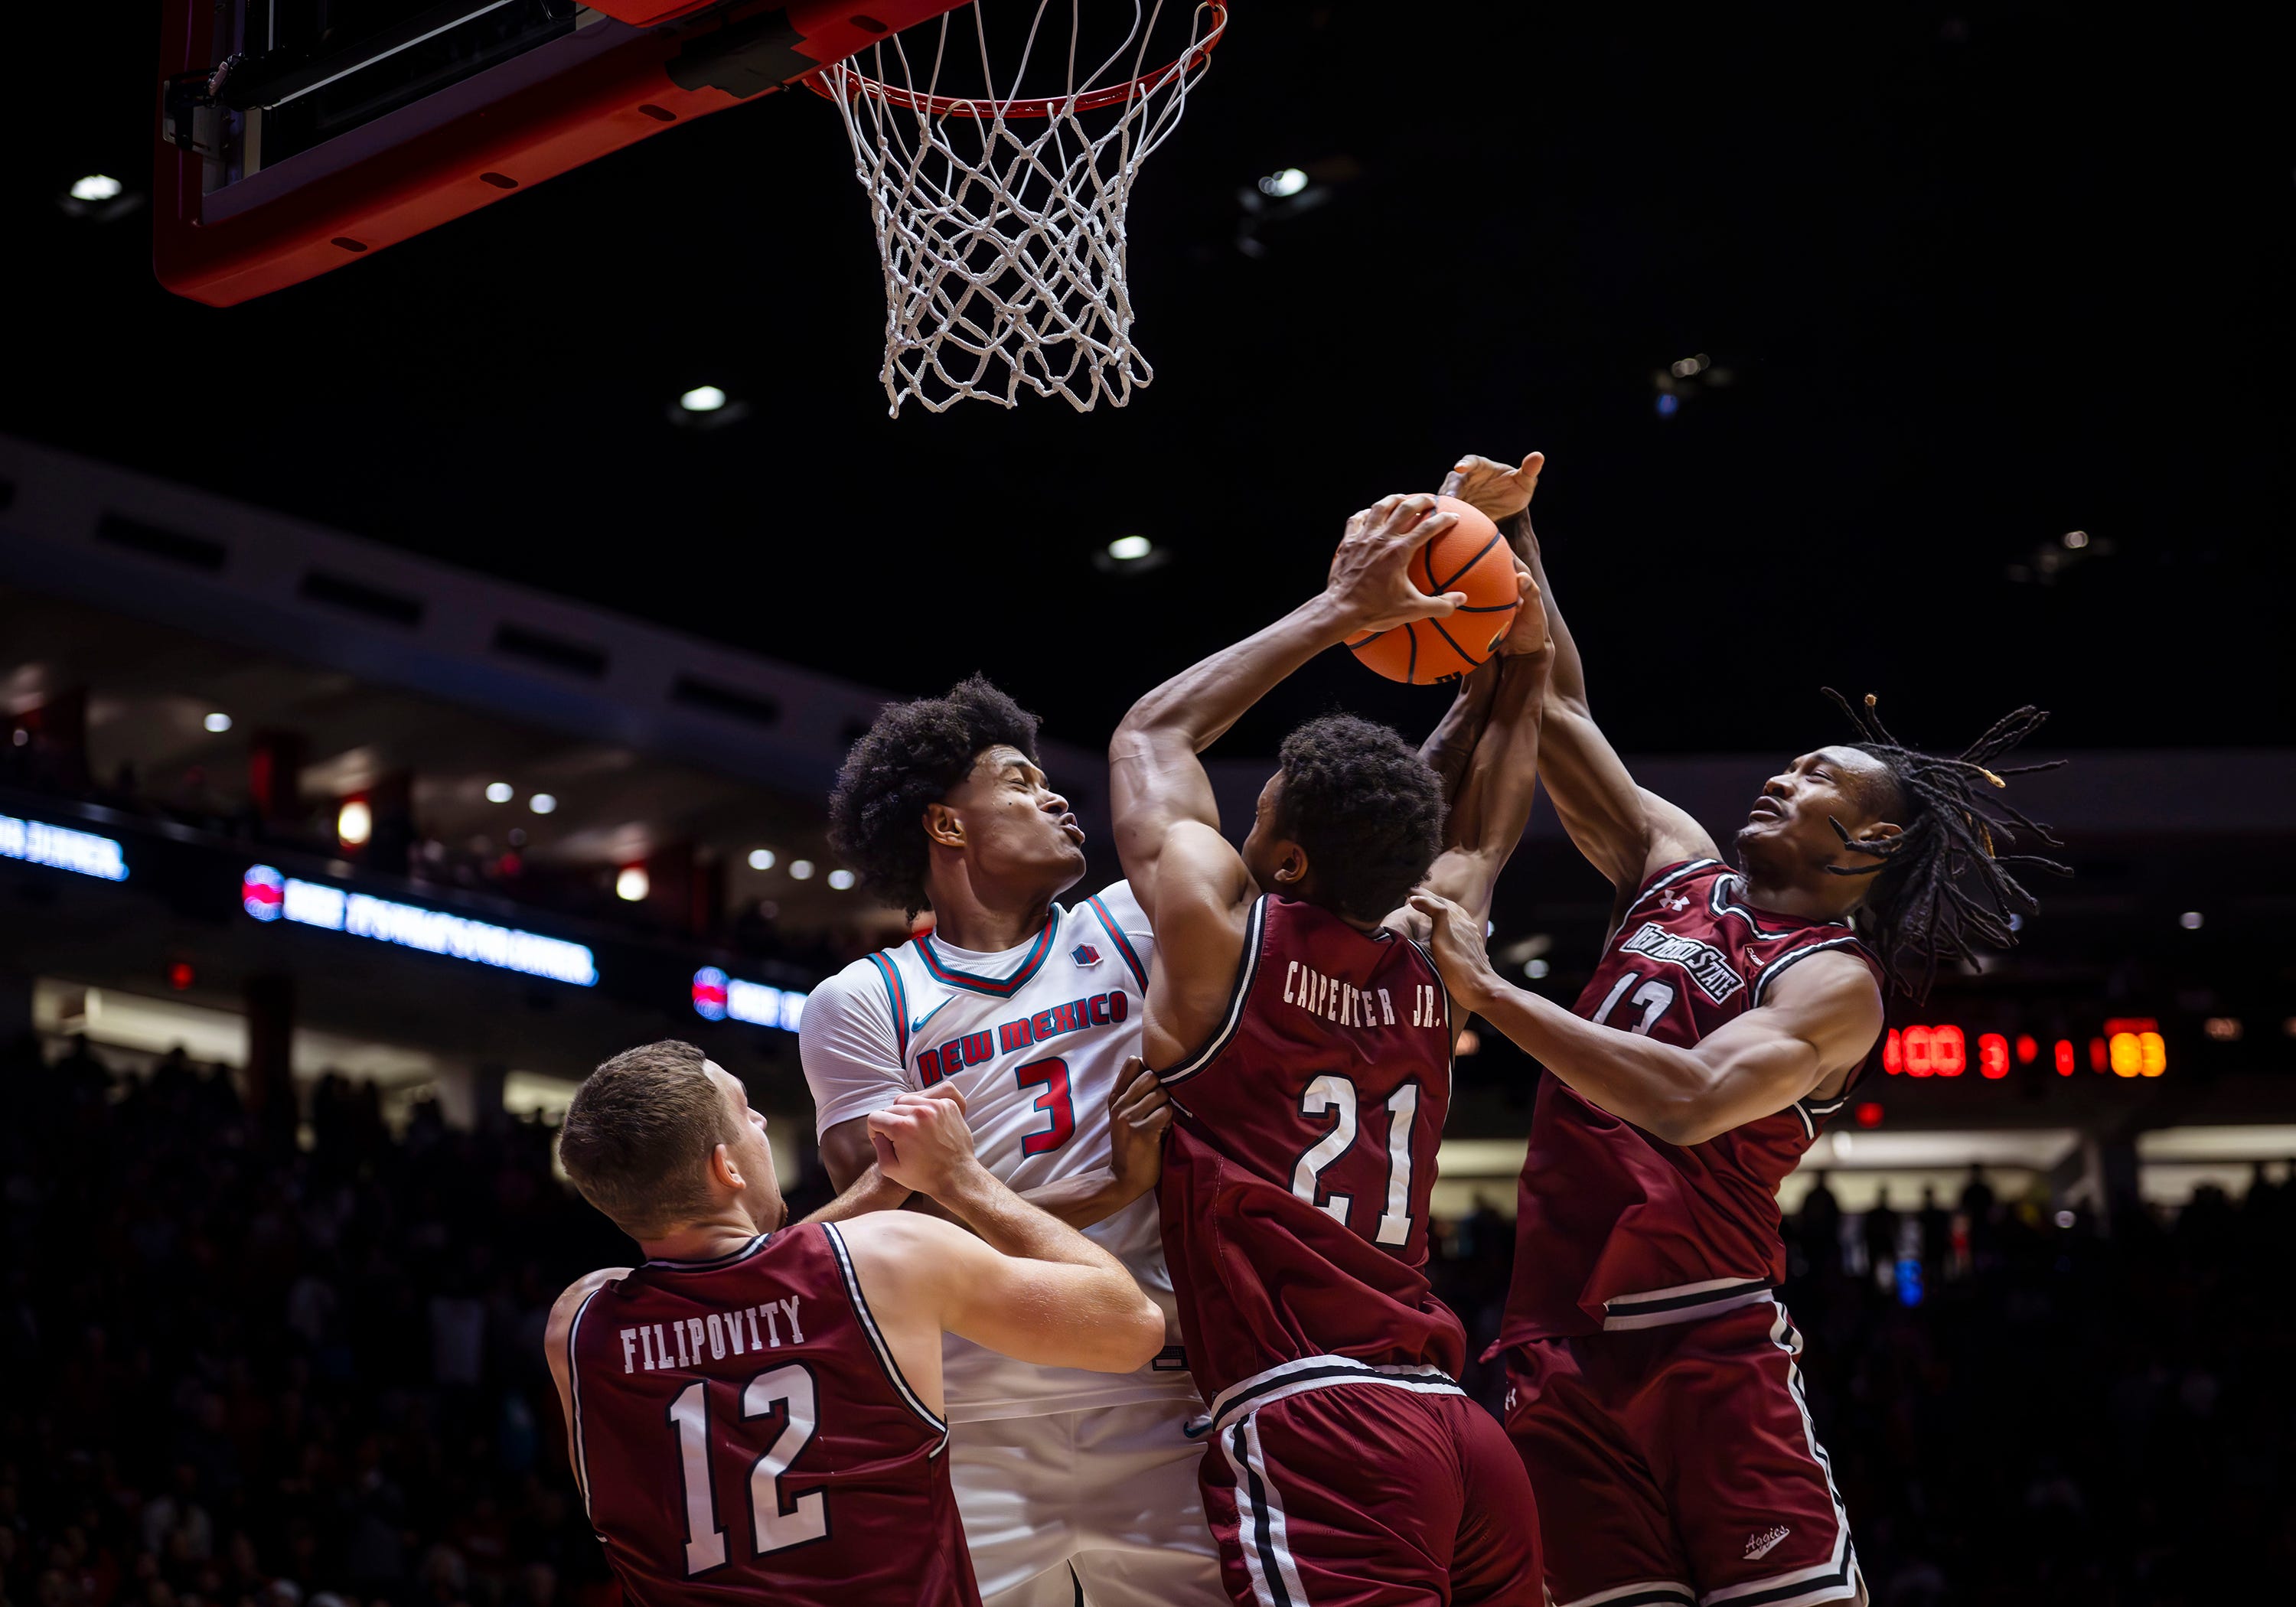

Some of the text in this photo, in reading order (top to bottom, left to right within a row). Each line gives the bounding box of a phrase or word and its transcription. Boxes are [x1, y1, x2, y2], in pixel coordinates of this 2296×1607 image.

[1283, 960, 1440, 1028] CARPENTER JR.
[1685, 950, 1737, 996] STATE
[916, 990, 1128, 1088] NEW MEXICO
[1014, 1056, 1076, 1159] 3
[1287, 1073, 1420, 1250] 21
[620, 1295, 806, 1374] FILIPOVITY
[664, 1358, 832, 1581] 12
